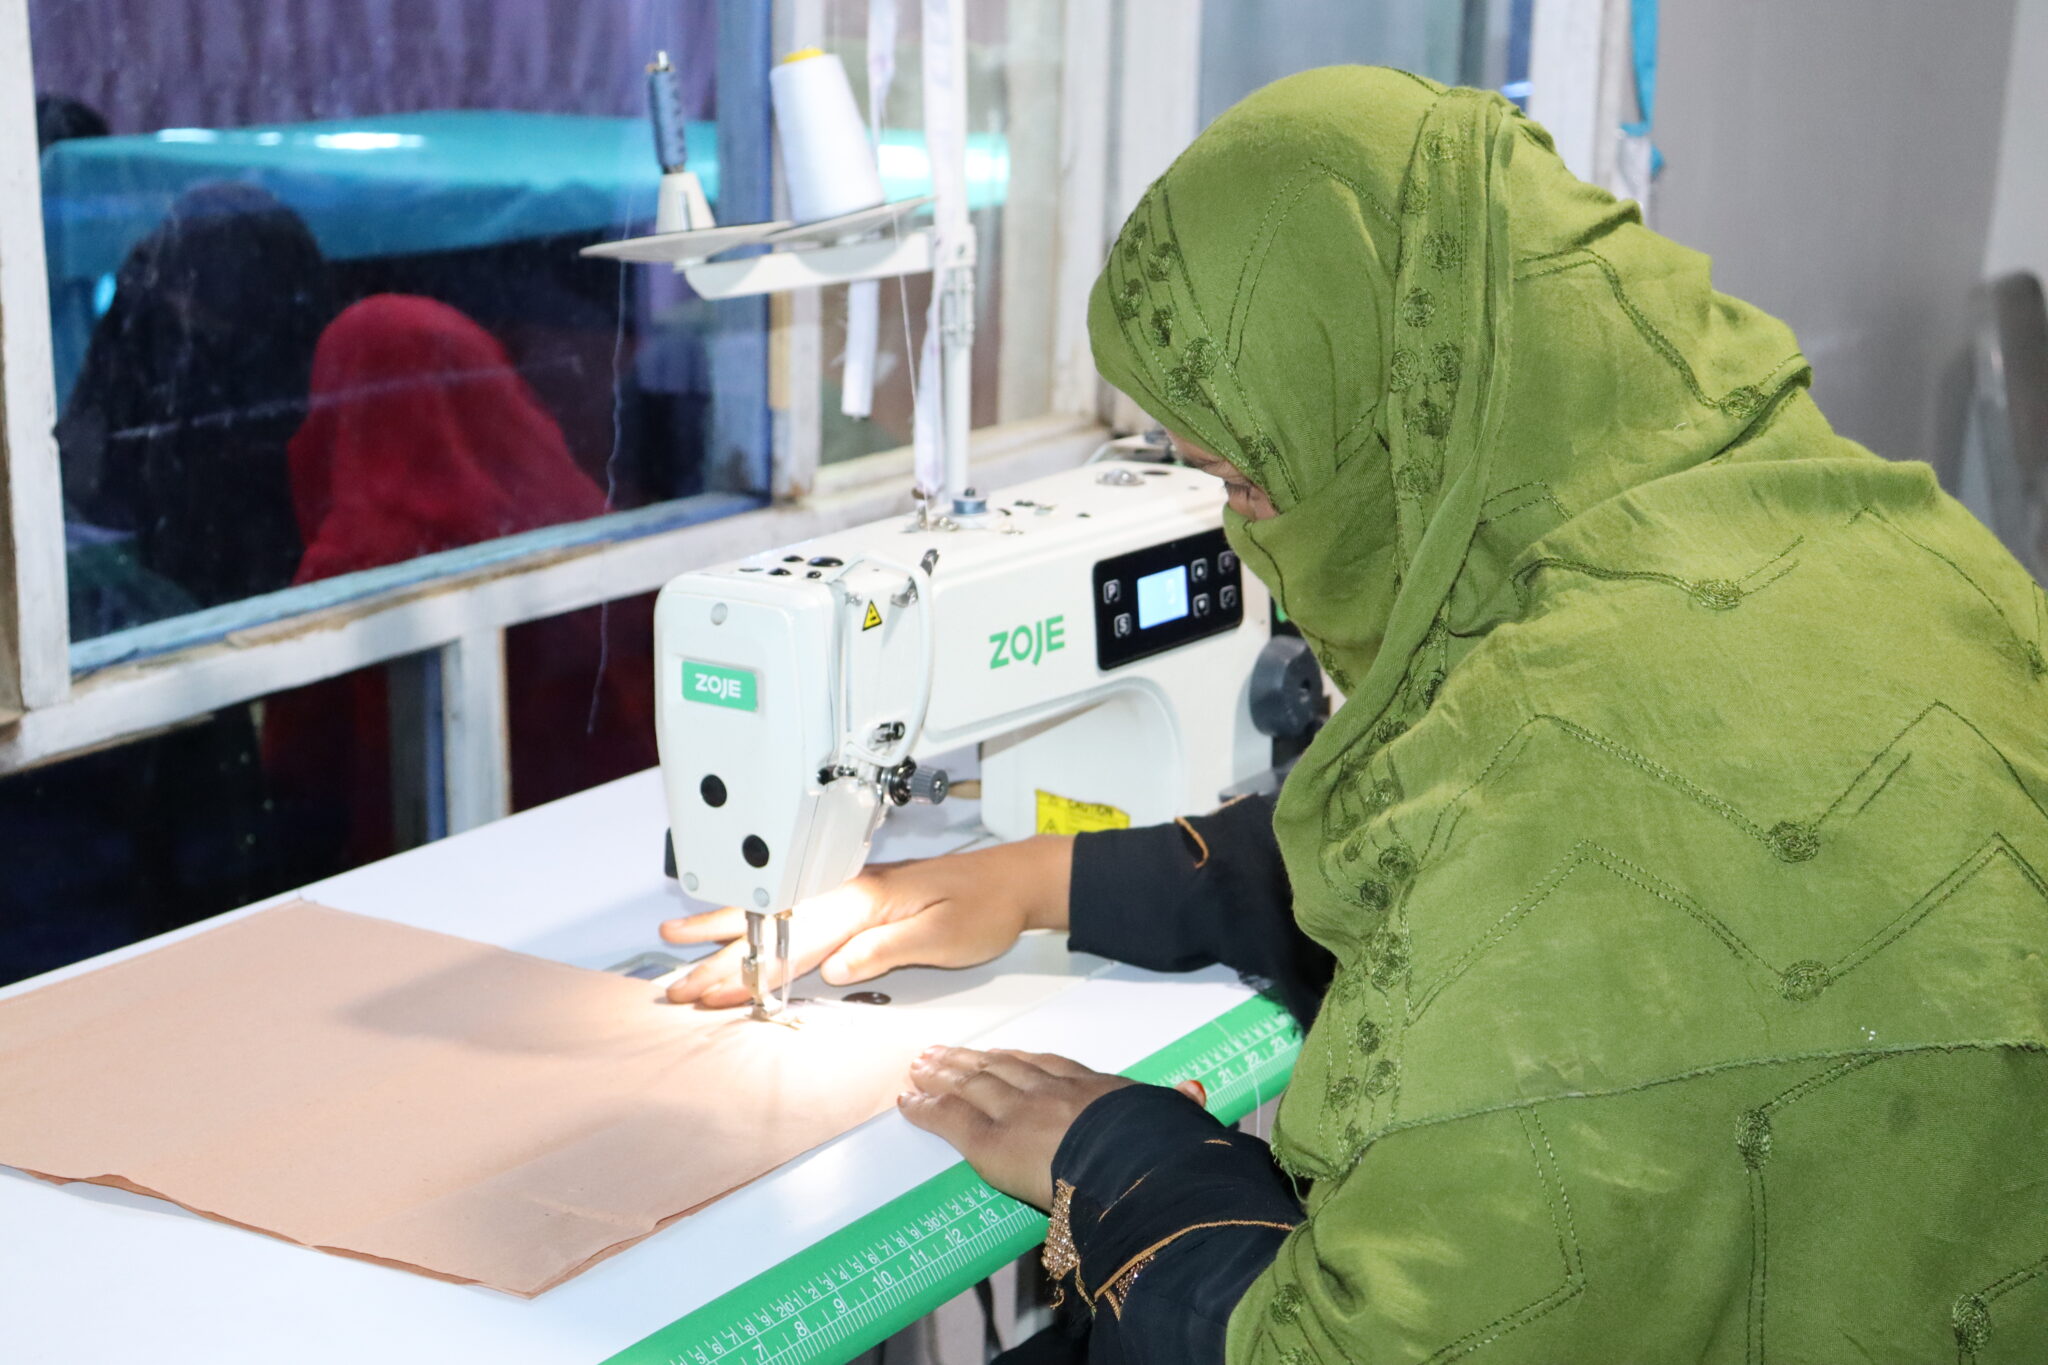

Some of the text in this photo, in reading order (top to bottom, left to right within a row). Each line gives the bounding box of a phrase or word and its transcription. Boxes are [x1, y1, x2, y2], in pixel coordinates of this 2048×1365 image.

[1108, 584, 1117, 599] P
[989, 614, 1065, 669] ZOJE
[1119, 618, 1128, 634] S
[695, 673, 742, 700] ZOJE
[1218, 1067, 1238, 1084] 21
[1244, 1051, 1263, 1068] 22
[694, 1352, 706, 1365] 5
[711, 1343, 723, 1355] 6
[726, 1333, 737, 1345] 7
[744, 1324, 755, 1336] 8
[760, 1315, 771, 1327] 9
[807, 1287, 819, 1300] 2
[823, 1278, 834, 1290] 3
[839, 1270, 849, 1280] 4
[852, 1261, 863, 1273] 5
[867, 1253, 878, 1265] 6
[880, 1244, 890, 1256] 7
[895, 1236, 906, 1248] 8
[910, 1228, 920, 1240] 9
[951, 1204, 961, 1216] 2
[965, 1196, 975, 1208] 3
[752, 1208, 999, 1360] 7 8 9 10 11 12 13
